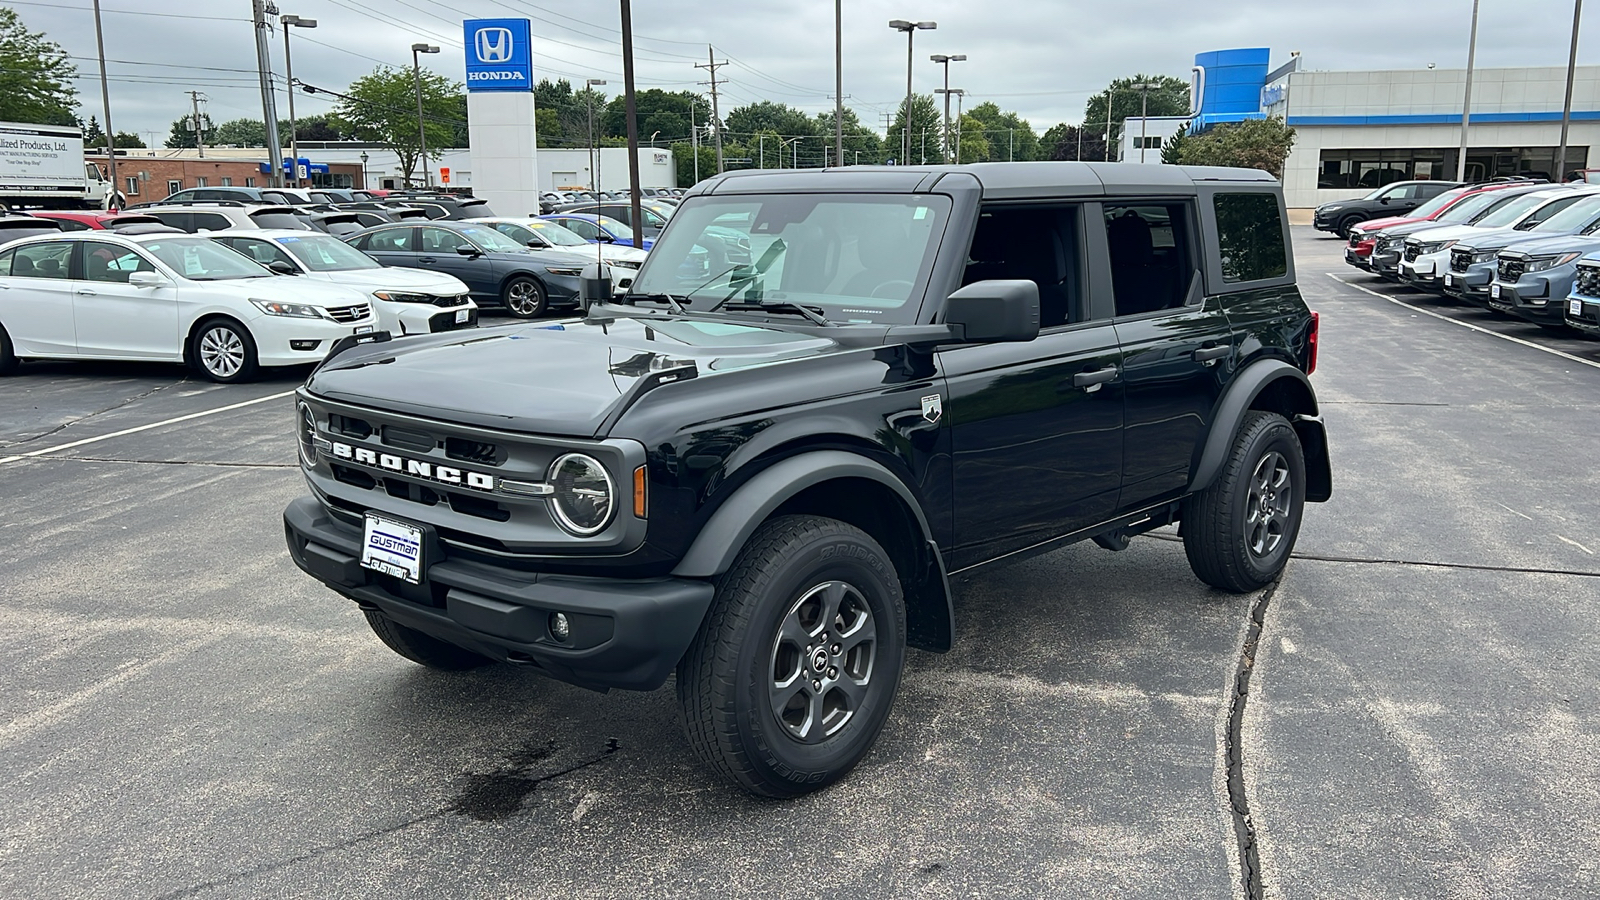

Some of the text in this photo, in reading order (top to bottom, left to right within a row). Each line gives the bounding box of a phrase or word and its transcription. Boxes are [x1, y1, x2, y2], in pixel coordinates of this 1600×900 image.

[468, 71, 525, 80] HONDA
[0, 139, 68, 152] lized Products, Ltd.
[333, 442, 494, 490] BRONCO
